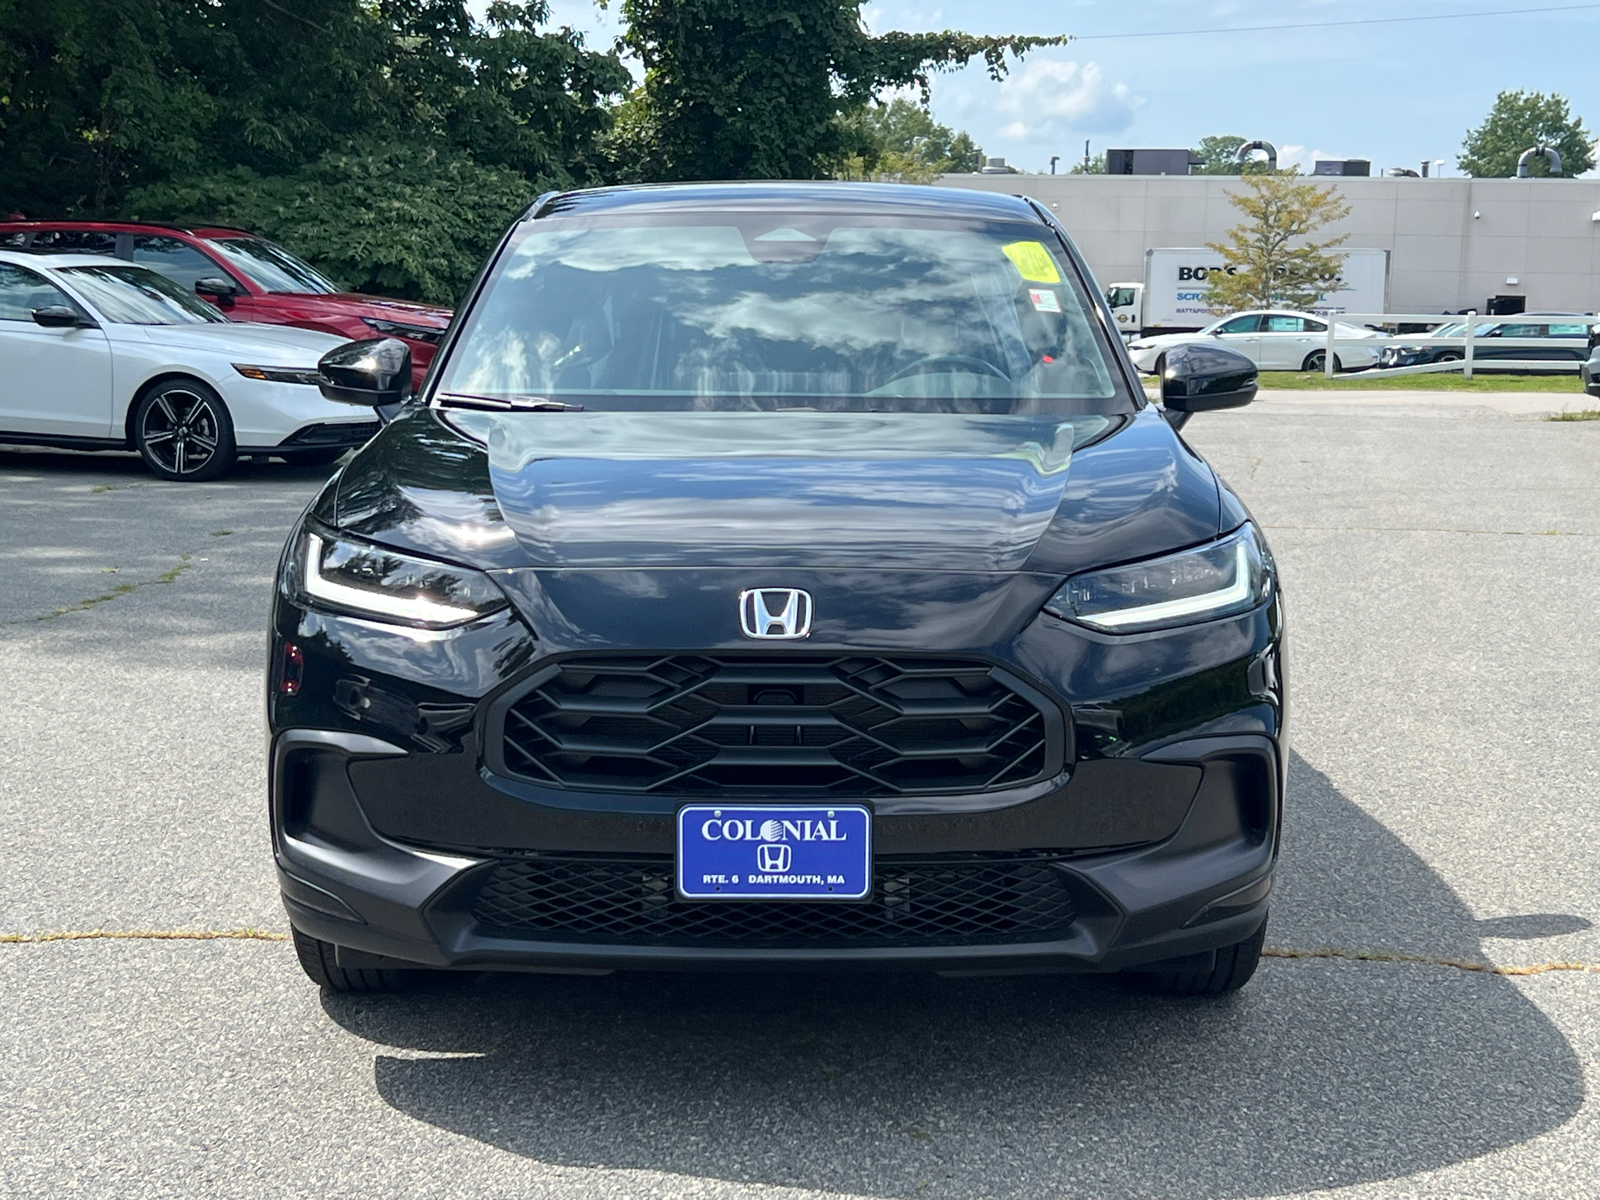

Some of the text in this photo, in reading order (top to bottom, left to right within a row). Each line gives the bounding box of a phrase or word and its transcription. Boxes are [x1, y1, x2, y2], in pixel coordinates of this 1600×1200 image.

[1178, 266, 1237, 281] BO'S
[702, 819, 848, 842] COLONIAL
[703, 875, 845, 886] RTE. 6 DARTMOUTH, MA
